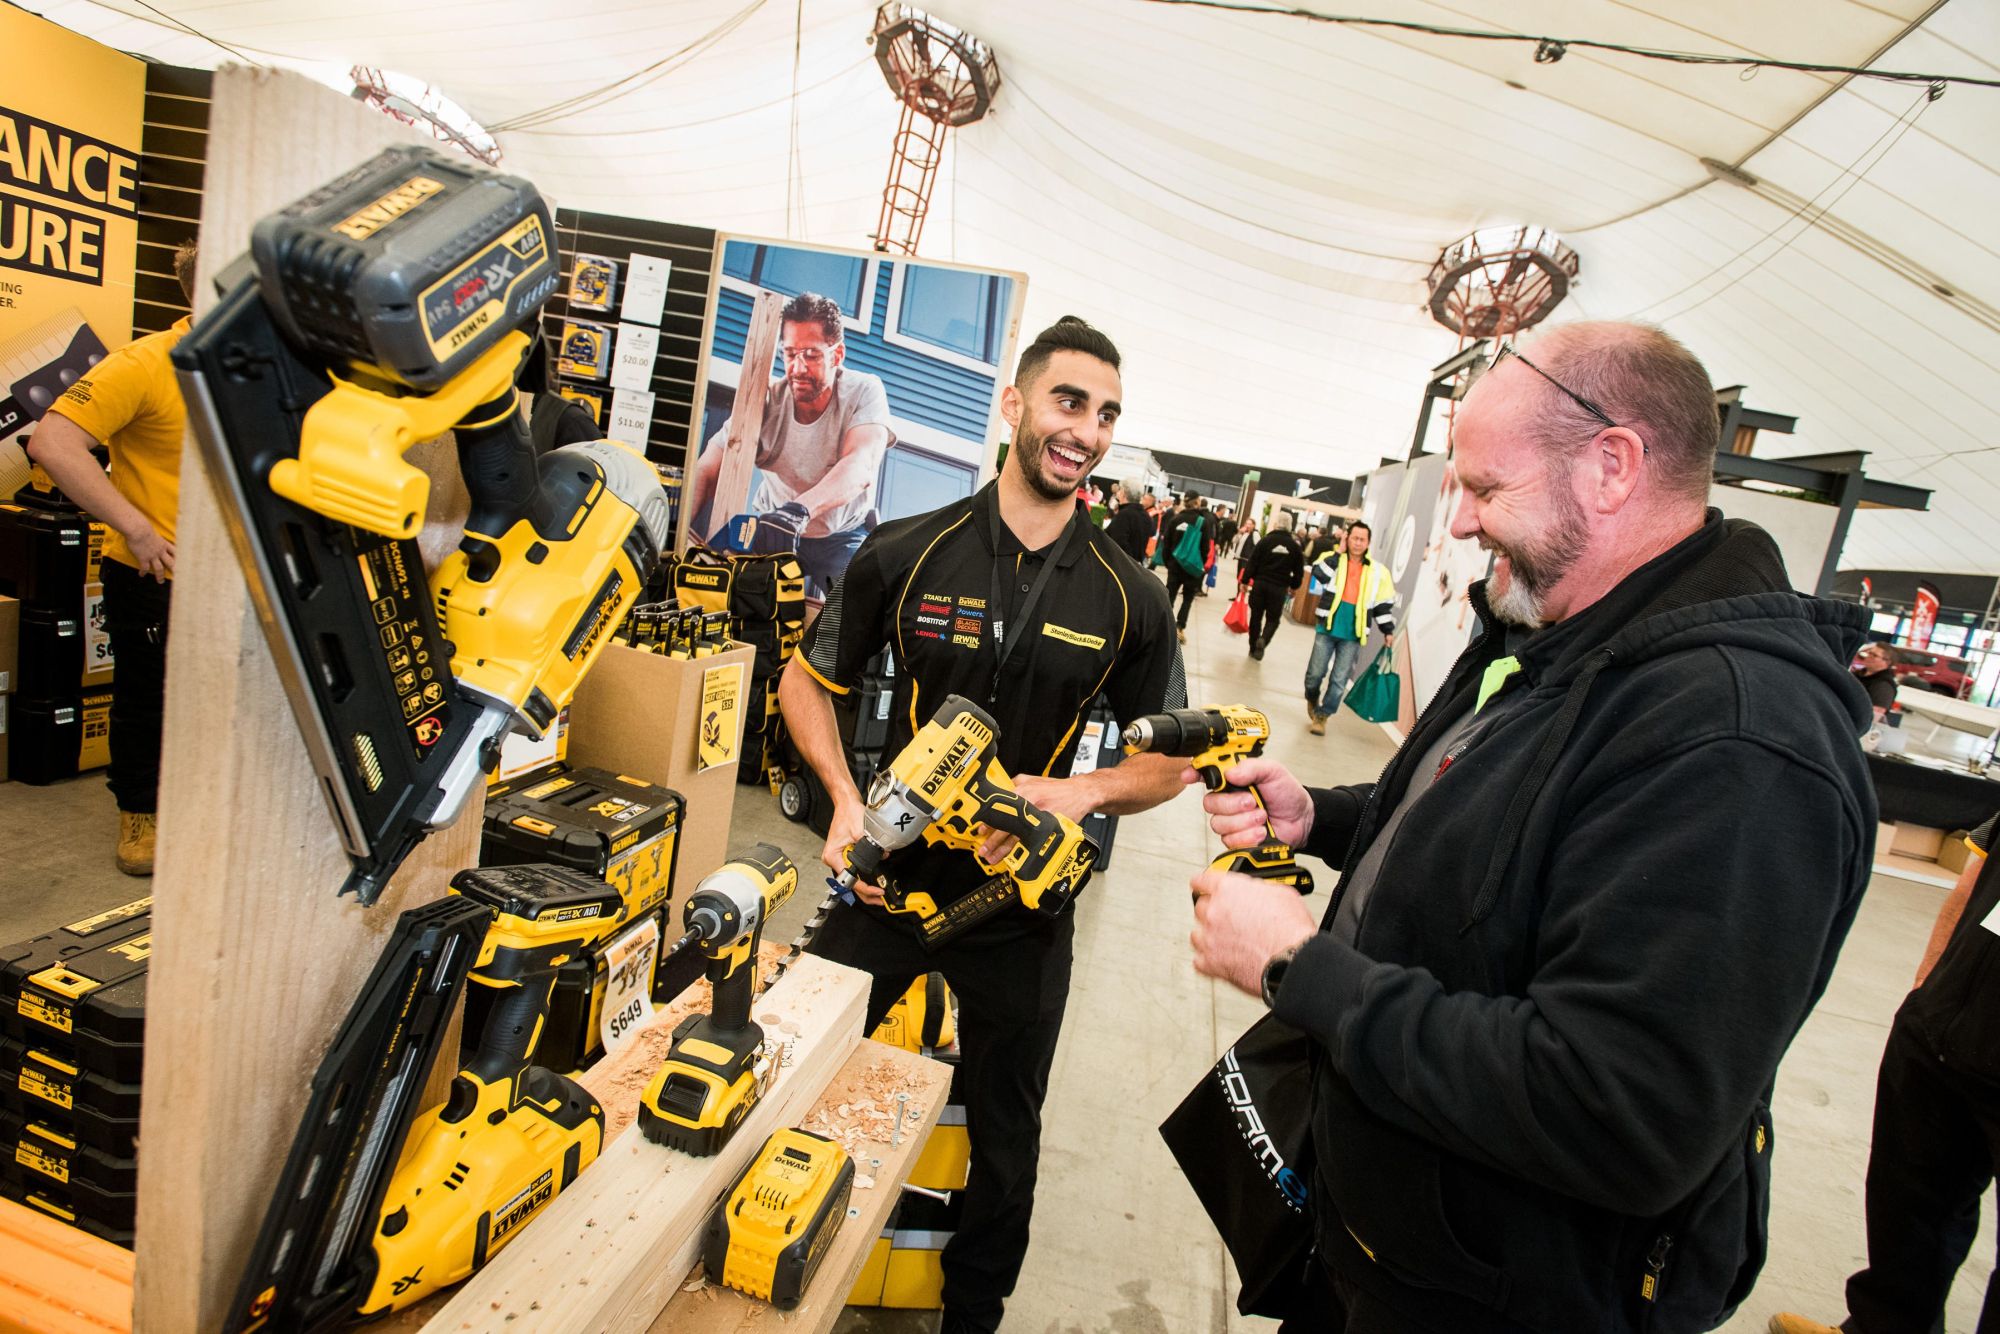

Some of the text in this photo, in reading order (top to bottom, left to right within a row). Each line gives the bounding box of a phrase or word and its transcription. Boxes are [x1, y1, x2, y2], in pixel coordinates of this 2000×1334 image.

[0, 115, 138, 213] ANCE
[622, 354, 649, 368] $20.00
[617, 417, 645, 430] $11.00
[923, 594, 952, 603] STANLEY
[917, 616, 949, 626] BOSTITCH
[922, 736, 974, 796] DEWALT
[610, 999, 642, 1039] $649
[774, 1156, 812, 1173] DEWALT
[491, 1183, 553, 1242] DEWALT
